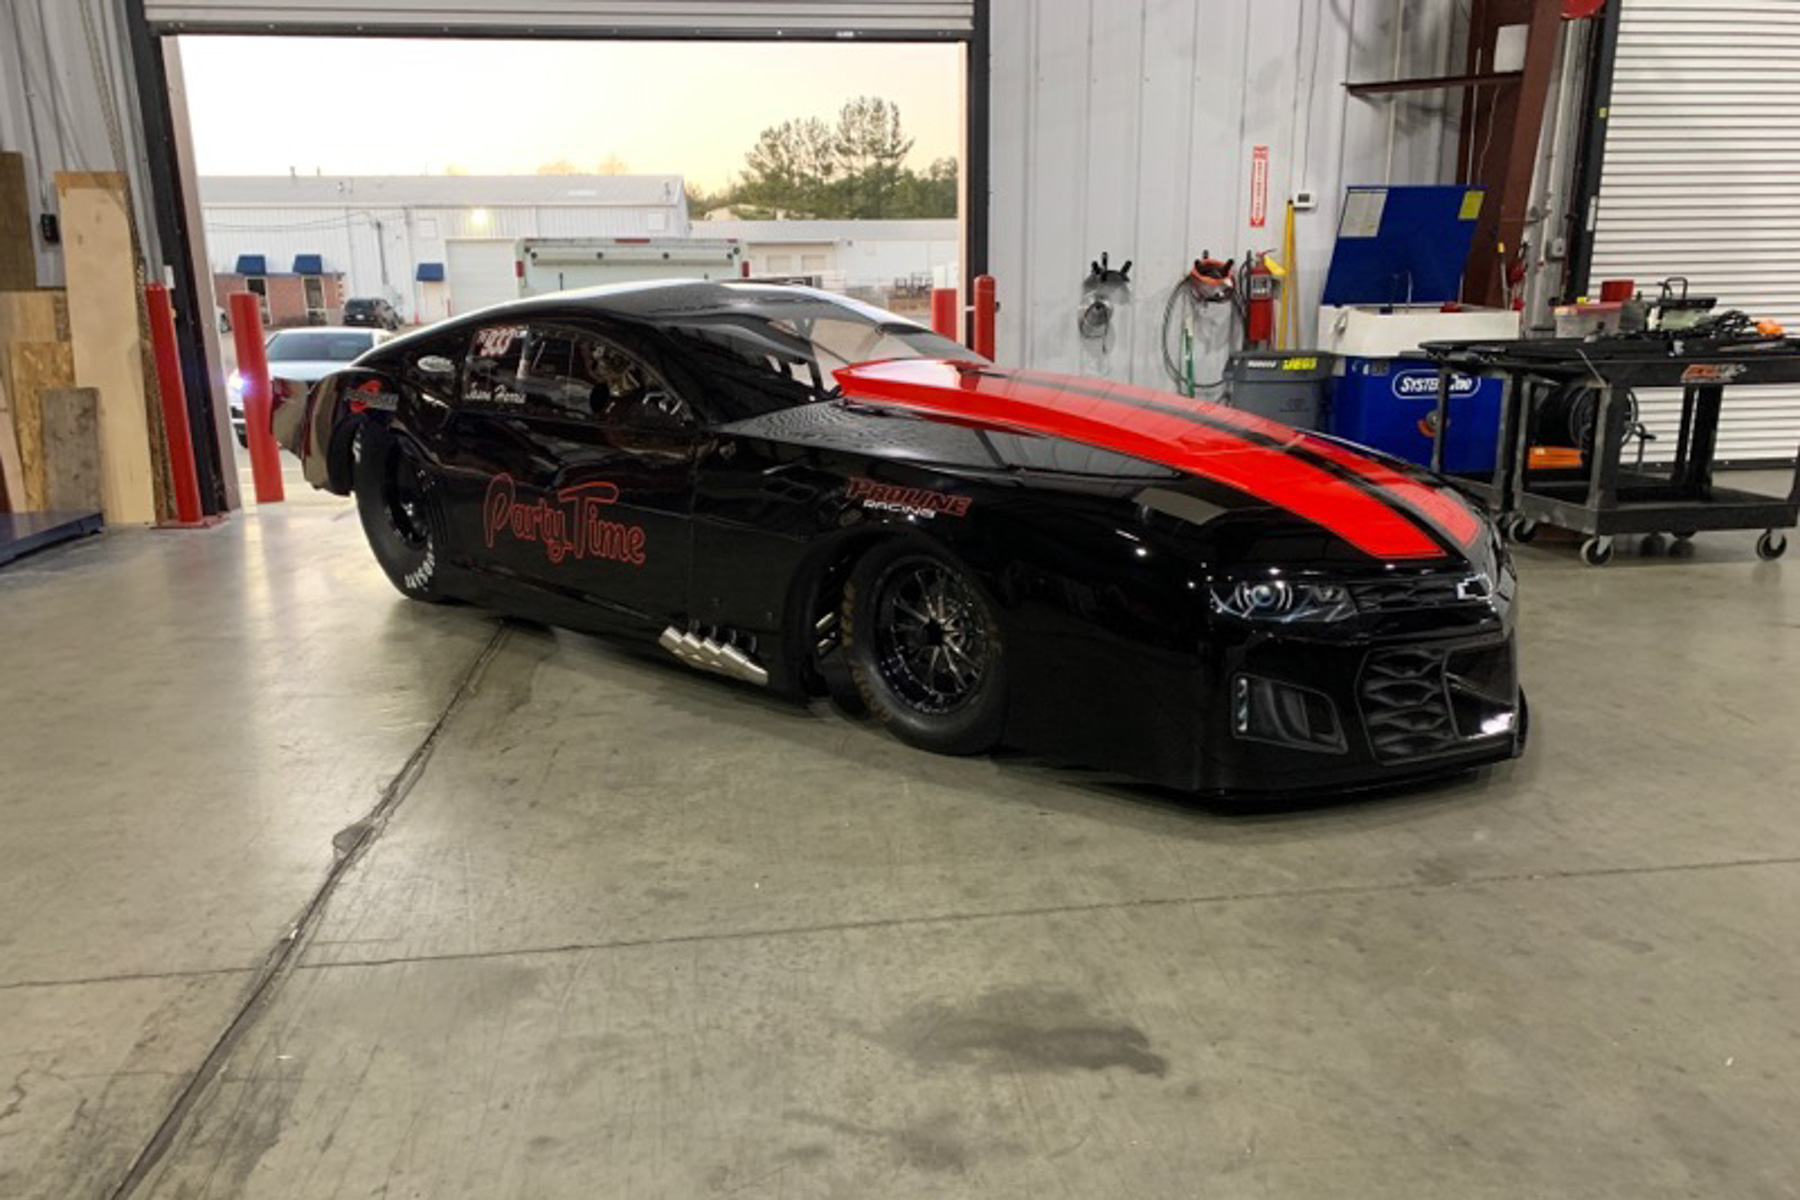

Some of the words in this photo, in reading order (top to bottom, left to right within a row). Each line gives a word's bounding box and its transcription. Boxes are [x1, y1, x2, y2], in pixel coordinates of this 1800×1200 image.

[1400, 376, 1440, 392] SYSTE
[483, 472, 576, 563] Party
[557, 481, 646, 565] Time
[863, 499, 936, 519] RACING
